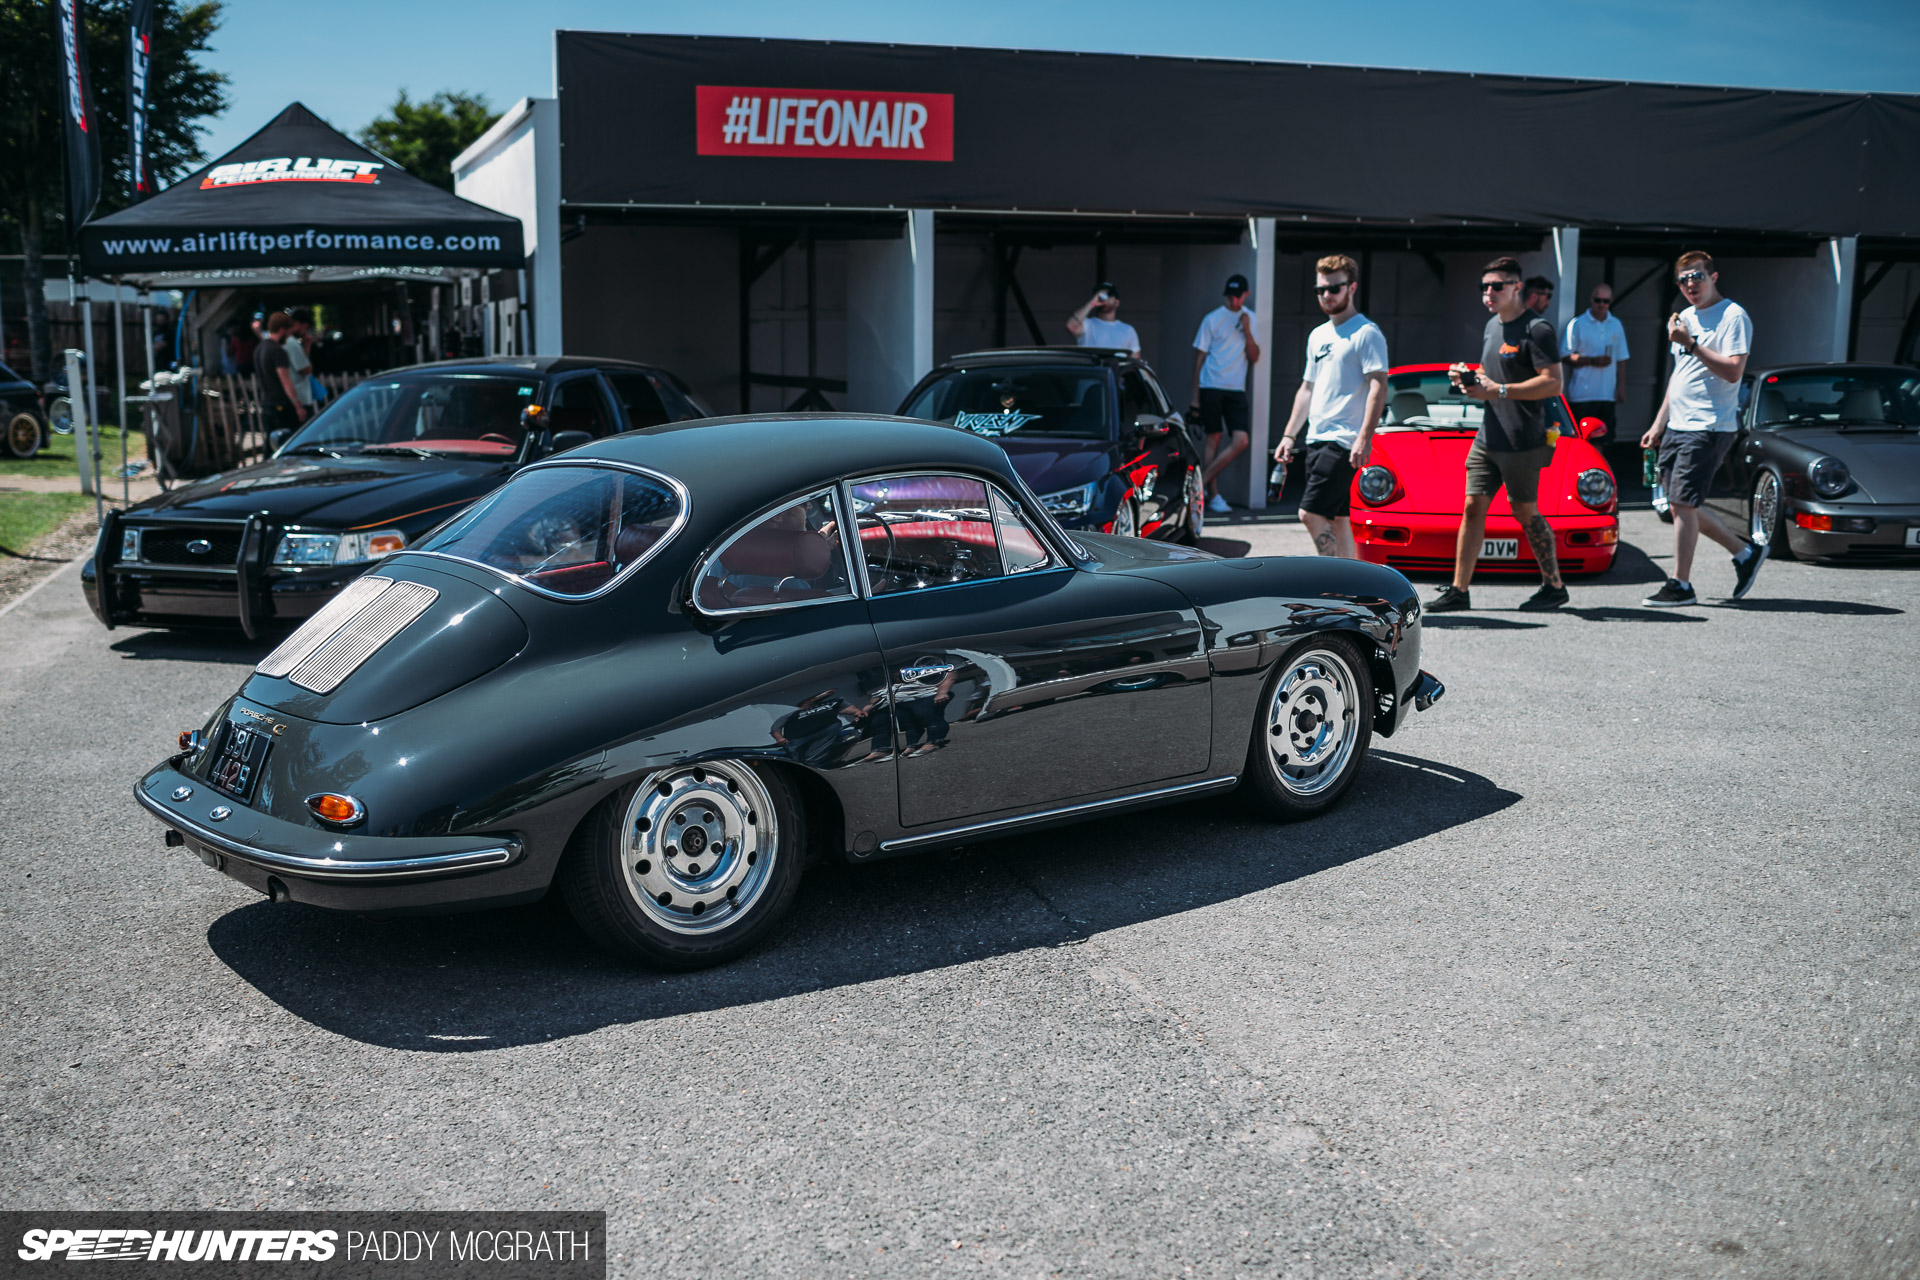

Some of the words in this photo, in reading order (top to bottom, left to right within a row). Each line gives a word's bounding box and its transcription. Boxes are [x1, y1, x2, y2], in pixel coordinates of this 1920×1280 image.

[722, 96, 928, 149] #LIFEONAIR
[208, 157, 293, 179] AIR
[293, 157, 385, 176] LIFT
[103, 230, 501, 254] www.airliftperformance.com
[1484, 541, 1517, 556] DVM
[240, 707, 275, 724] PORSCHE
[272, 723, 287, 736] C
